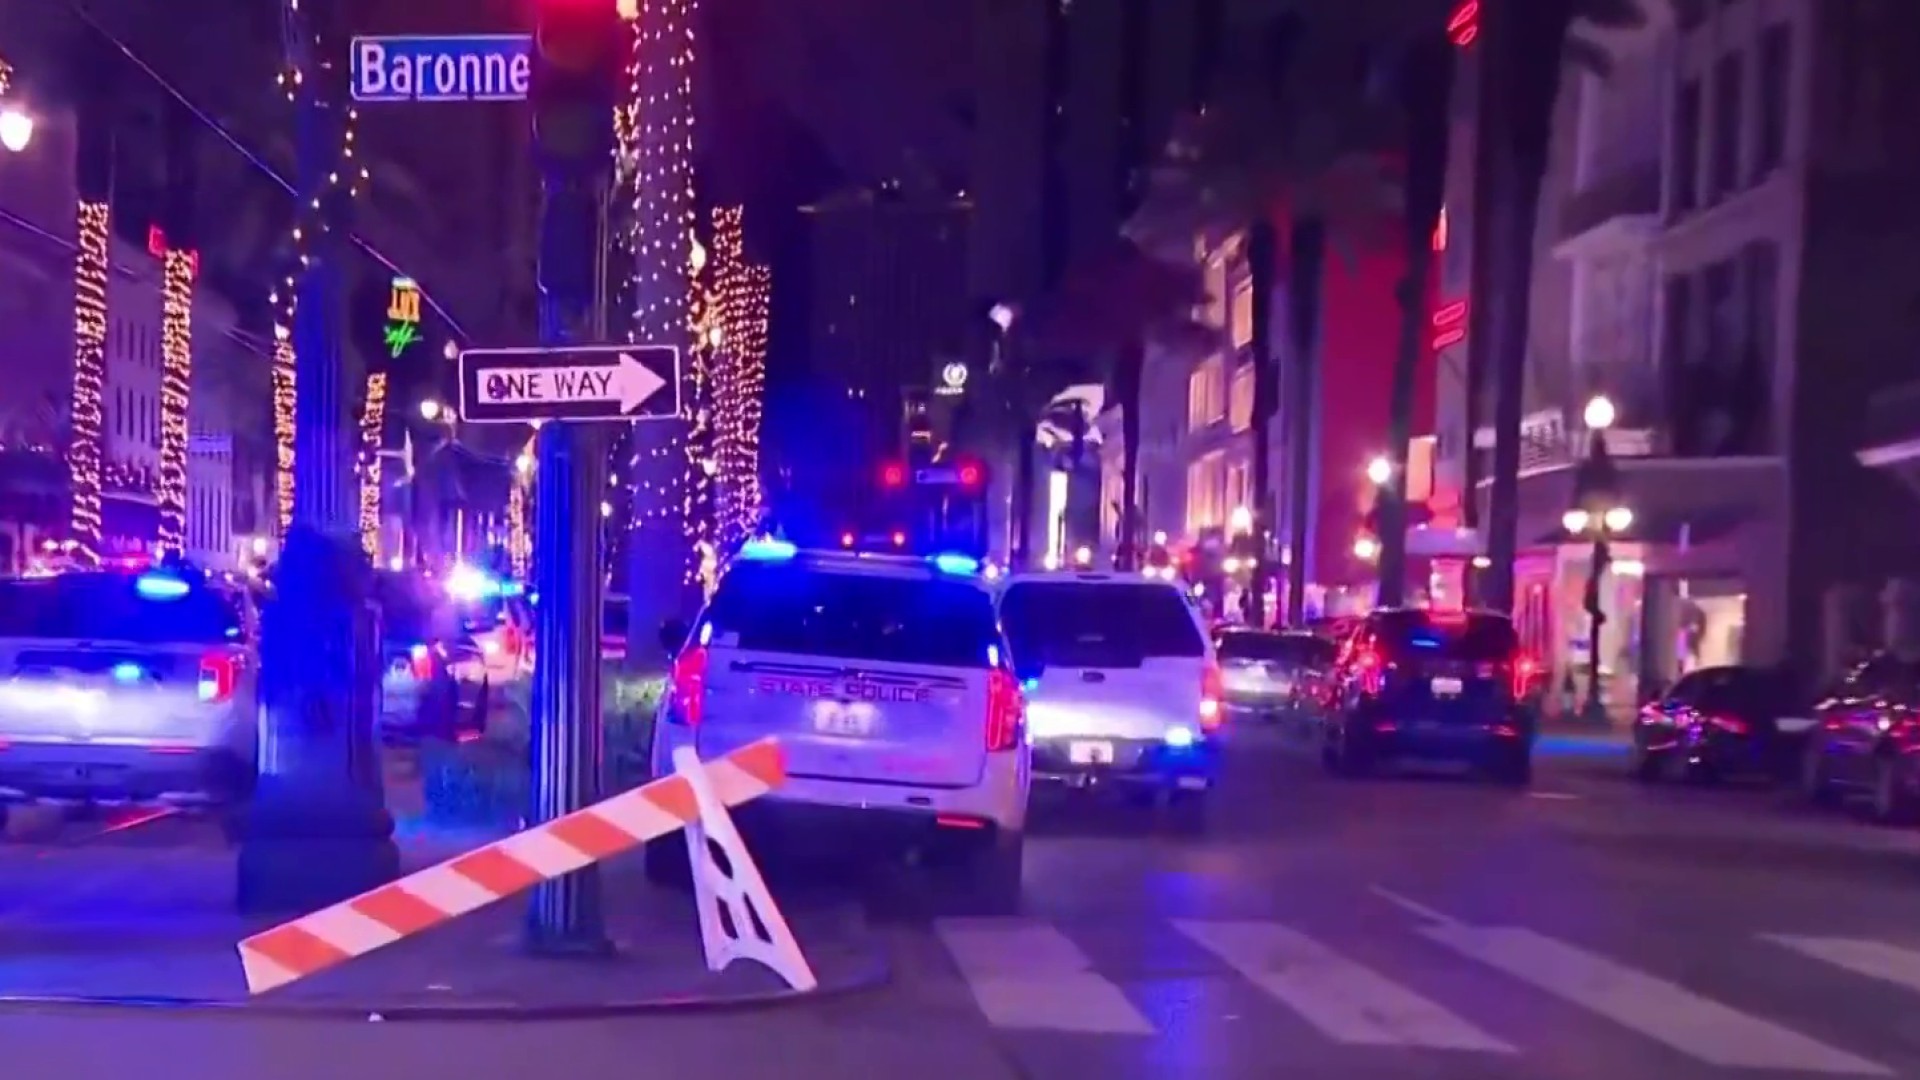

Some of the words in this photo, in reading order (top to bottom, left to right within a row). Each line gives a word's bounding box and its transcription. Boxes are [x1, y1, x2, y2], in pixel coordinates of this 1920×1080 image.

[360, 43, 531, 94] Baronne
[486, 373, 543, 400] ONE
[554, 370, 612, 397] WAY
[759, 676, 834, 698] STATE
[844, 682, 931, 702] POLICE
